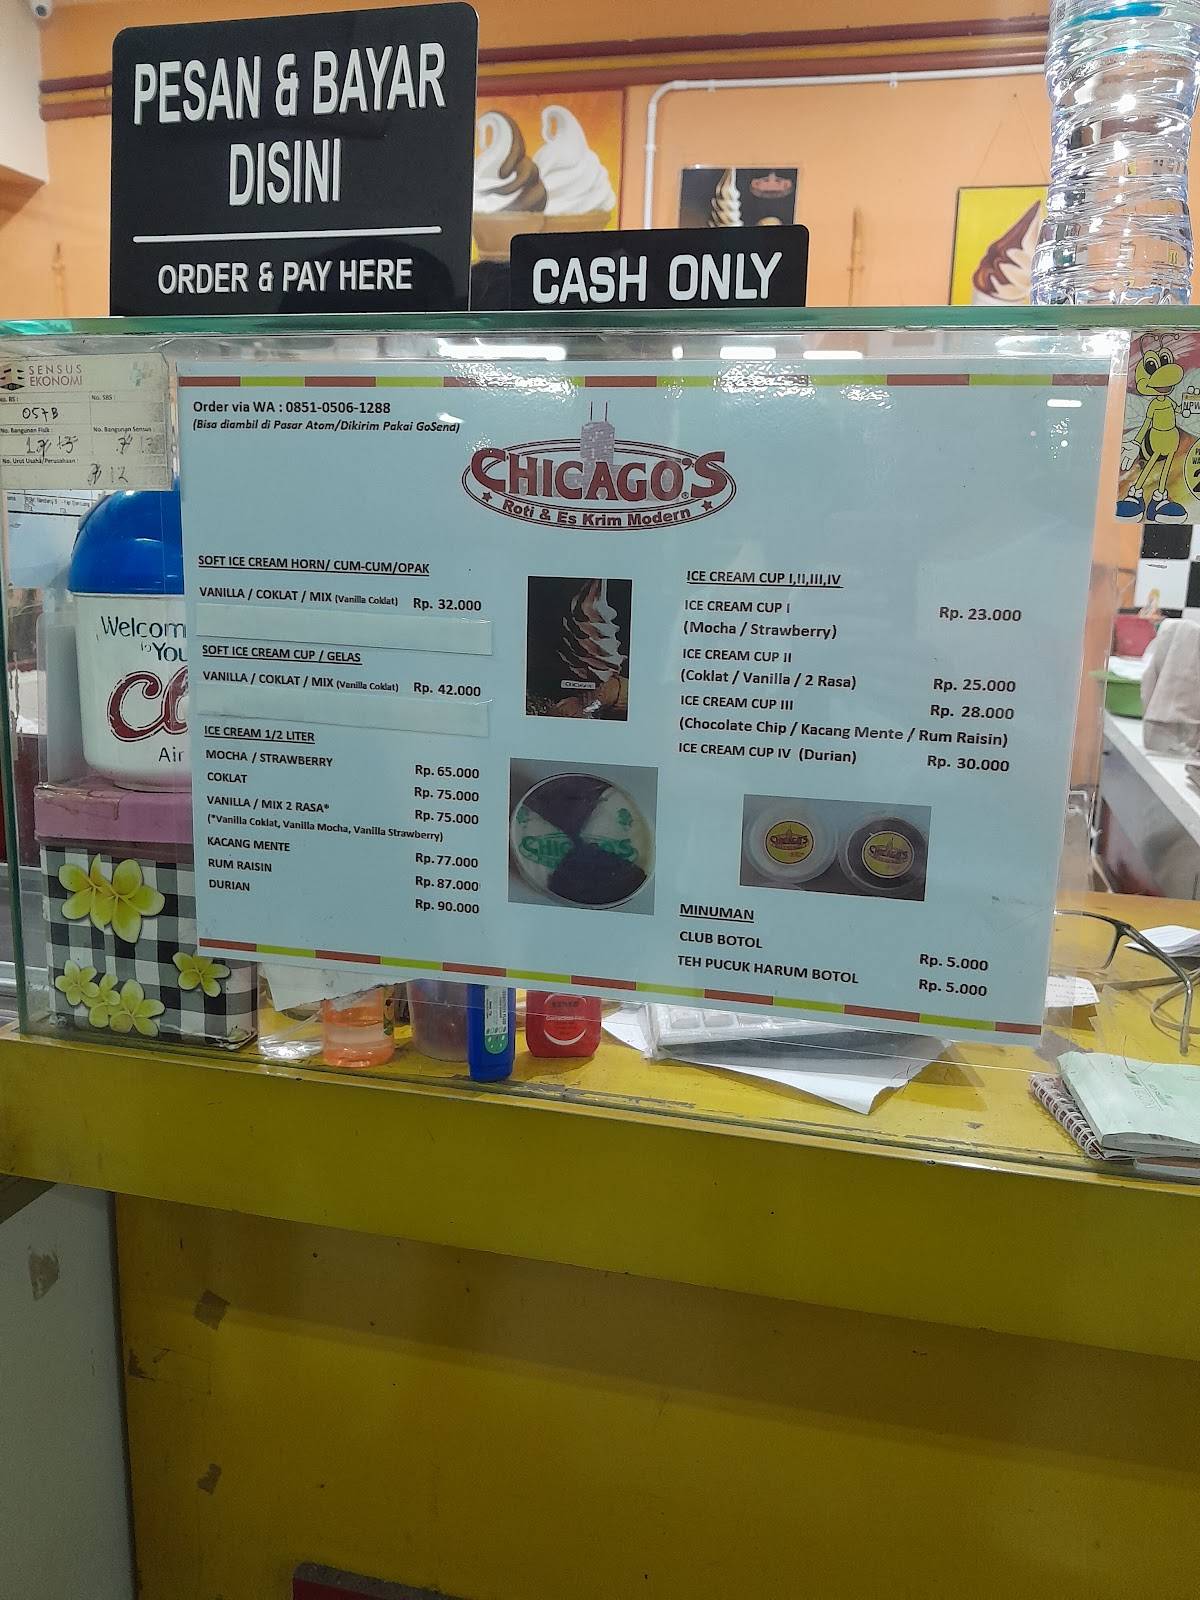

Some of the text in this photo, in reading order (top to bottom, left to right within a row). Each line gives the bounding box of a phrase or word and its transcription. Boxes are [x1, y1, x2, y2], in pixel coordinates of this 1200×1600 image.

[133, 42, 447, 125] PESAN & BAYAR
[229, 138, 342, 206] DISINI
[158, 258, 413, 295] ORDER & PAY HERE
[532, 251, 783, 304] CASH ONLY
[28, 364, 83, 376] SENSUS
[29, 375, 83, 388] EKONOMI
[193, 401, 391, 414] Order via WA 0851-0506-1288
[192, 419, 460, 434] (Bisa diambil di Pasar Atom/Dikirim Pakai GoSend)
[470, 447, 728, 502] CHICAGO'S
[502, 499, 692, 527] Roti & Es Krim Modern
[198, 555, 431, 575] SOFT ICE CREAM HORN/ CUM-CUM/OPAK
[686, 570, 707, 583] ICE
[708, 571, 756, 584] CREAM
[758, 572, 786, 585] CUP
[199, 587, 482, 612] VANILLA COKLAT MIX (Vanilla Coklat) Rp. 32.000
[684, 599, 705, 612] ICE
[706, 600, 753, 613] CREAM
[756, 601, 783, 614] CUP
[939, 606, 1022, 623] Rp. 23.000
[683, 620, 838, 640] (Mocha Strawberry)
[202, 644, 361, 663] SOFT ICE CREAM CUP GELAS
[682, 648, 792, 664] ICE CREAM CUP II
[202, 671, 482, 697] VANILLA COKLAT MIX (Vanilla Coklat) Rp. 42.000
[681, 668, 857, 690] (Coklat Vanilla 2 Rasa)
[933, 678, 1017, 694] Rp. 25.000
[680, 695, 794, 711] ICE CREAM CUP III
[929, 704, 1015, 720] Rp. 28.000
[204, 725, 315, 742] ICE CREAM 1/2 LITER
[679, 716, 1008, 749] (Chocolate Chip Kacang Mente Rum Raisin)
[205, 749, 334, 768] MOCHA STRAWBERRY
[678, 742, 857, 765] ICE CREAM CUP IV (Durian)
[927, 754, 1011, 772] Rp. 30.000
[207, 772, 248, 784] COKLAT
[415, 764, 480, 780] Rp. 65.000
[414, 786, 480, 802] Rp. 75.000
[206, 795, 251, 808] VANILLA
[261, 798, 283, 811] MIX
[285, 800, 293, 811] 2
[414, 809, 480, 825] Rp. 75.000
[249, 817, 281, 830] Coklat,
[283, 820, 316, 832] Vanilla
[317, 822, 352, 835] Mocha,
[353, 825, 387, 837] Vanilla
[388, 827, 444, 843] Strawberry)
[207, 836, 291, 852] KACANG MENTE
[208, 858, 273, 873] RUM RAISIN
[415, 852, 479, 869] Rp. 77.000
[208, 879, 251, 892] DURIAN
[415, 875, 480, 892] Rp. 87.000
[415, 898, 480, 915] Rp. 90.000
[679, 903, 755, 921] MINUMAN
[679, 930, 763, 949] CLUB BOTOL
[678, 954, 859, 985] TEH PUCUK HARUM BOTOL
[919, 953, 989, 972] Rp. 5.000
[918, 978, 988, 998] Rp. 5.000
